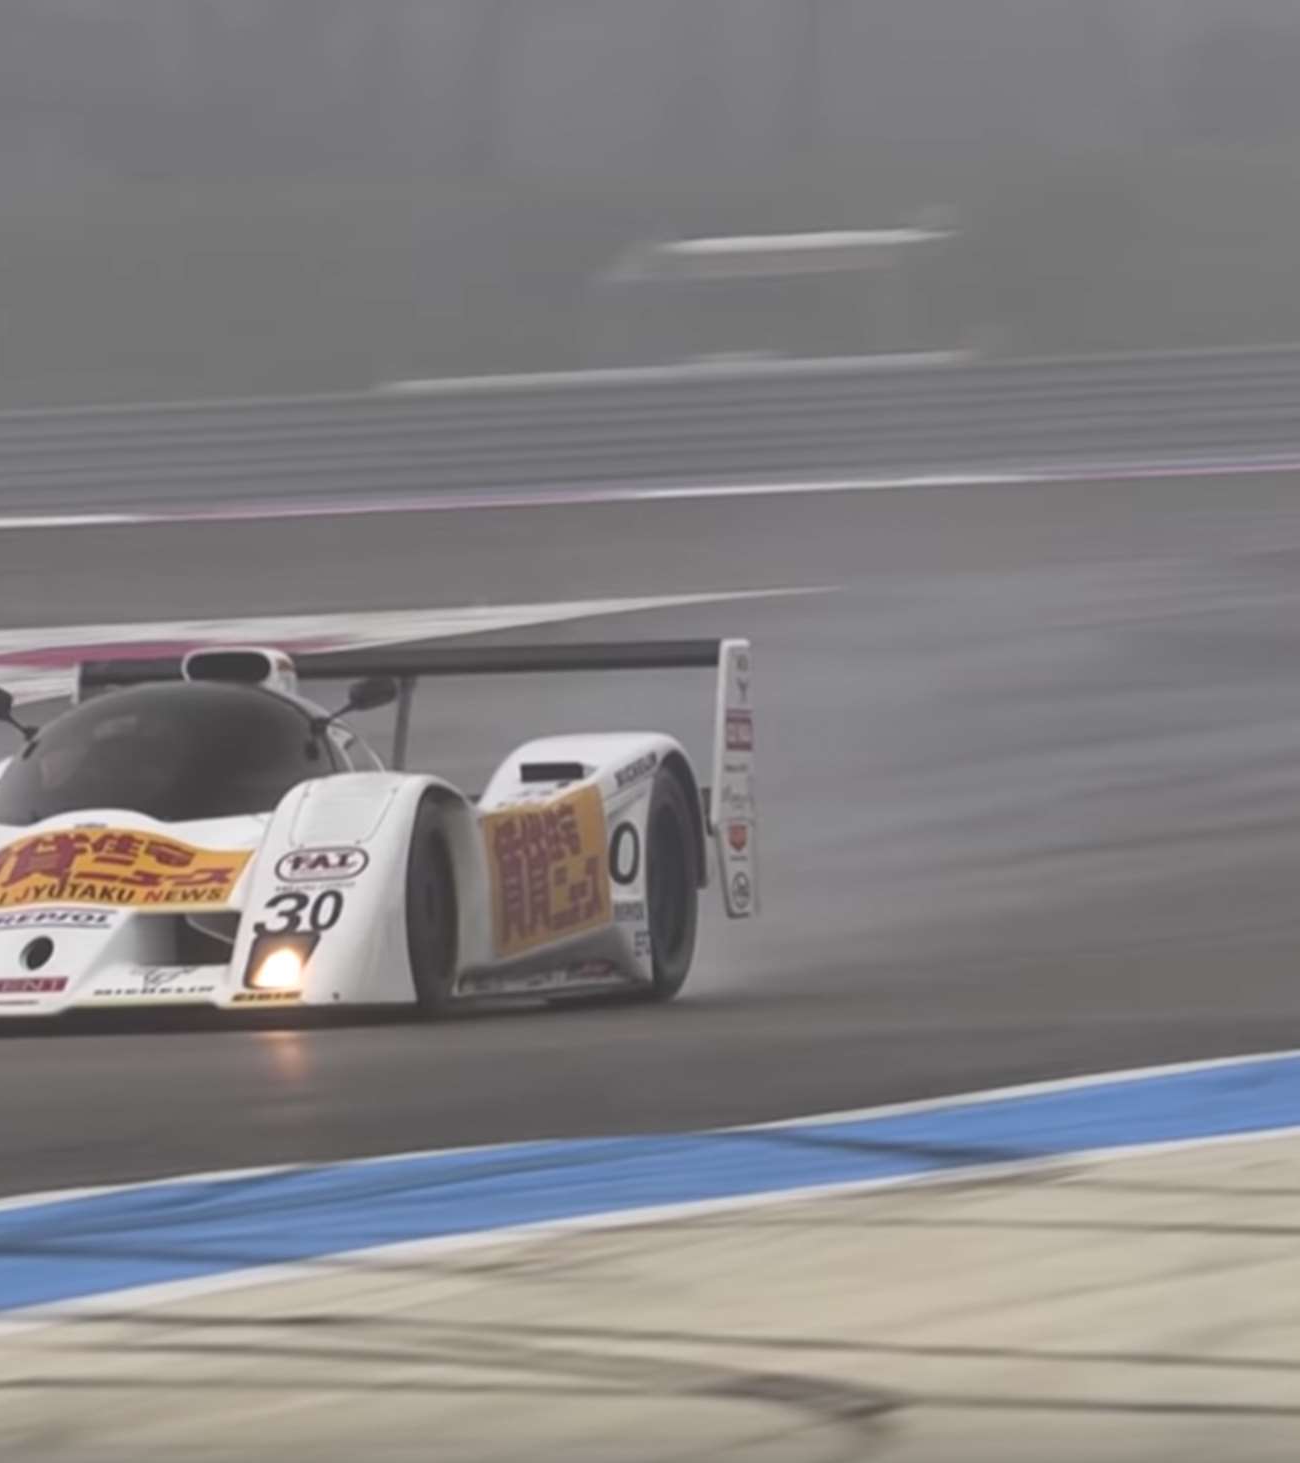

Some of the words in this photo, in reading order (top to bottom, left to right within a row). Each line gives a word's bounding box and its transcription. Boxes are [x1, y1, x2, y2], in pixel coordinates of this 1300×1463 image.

[14, 882, 135, 905] JYUTAKU
[143, 887, 223, 901] NEWS
[253, 889, 344, 934] 30
